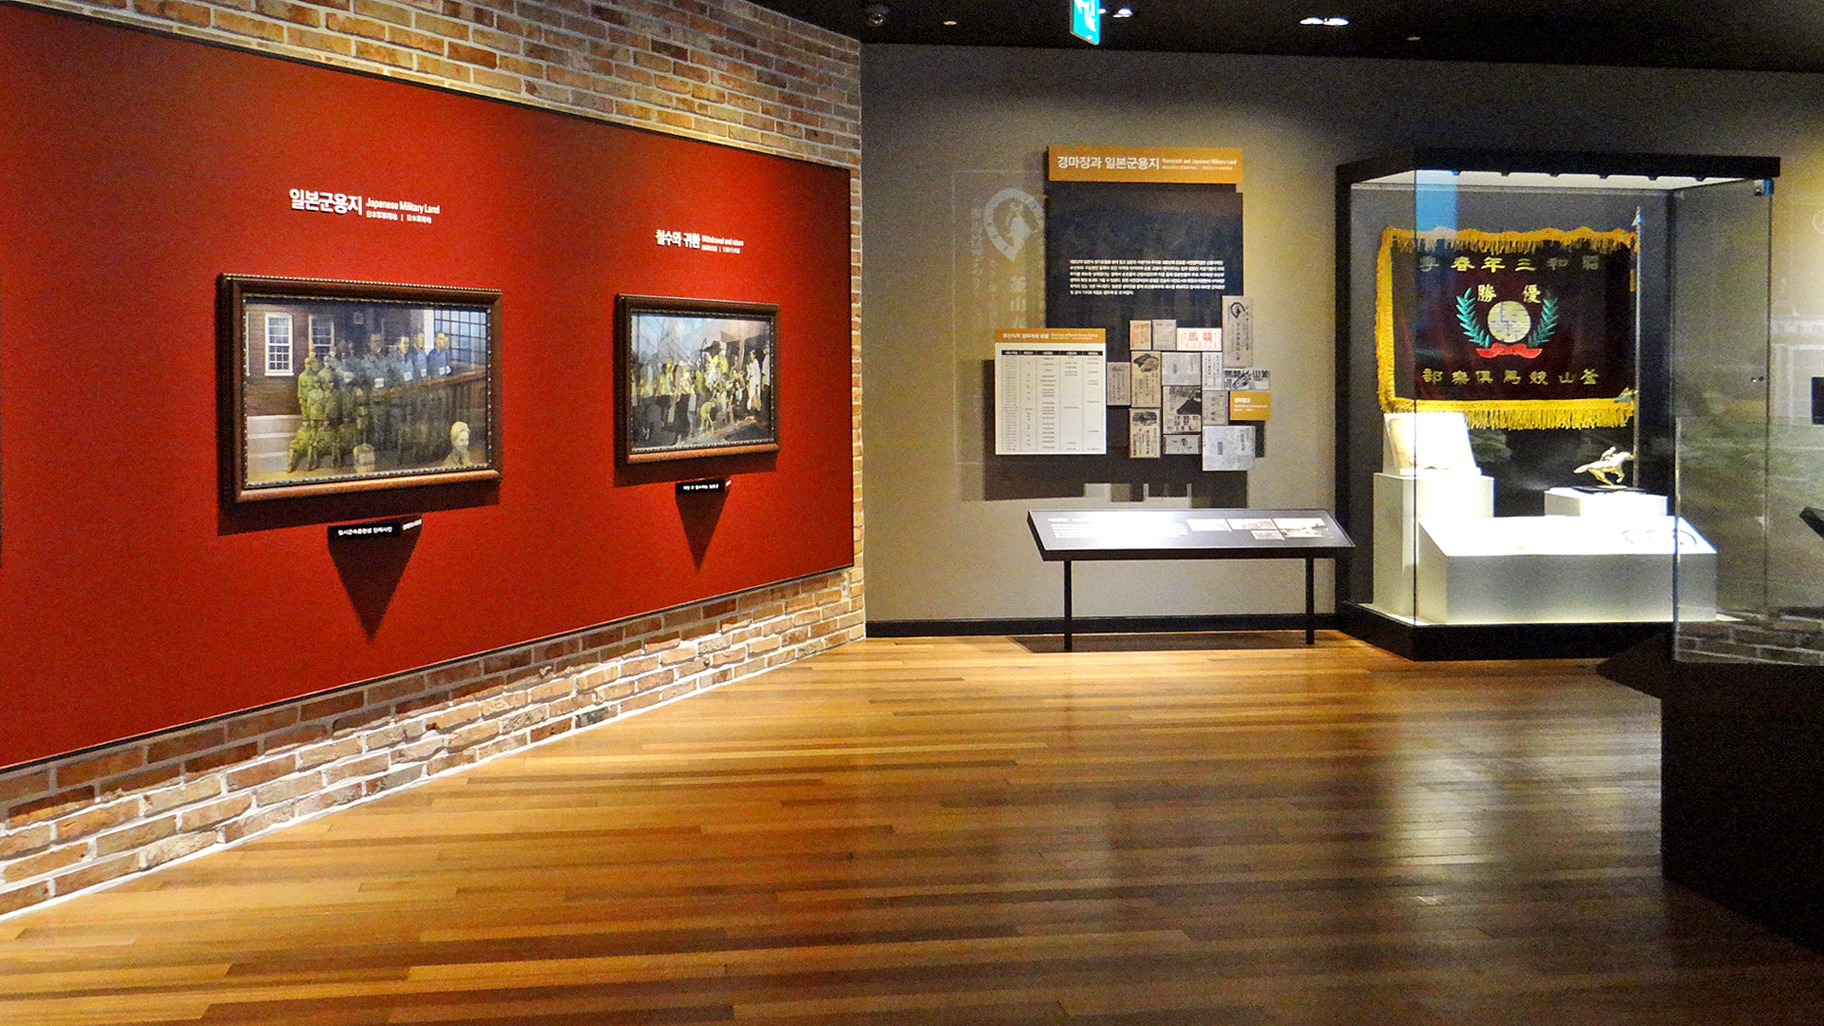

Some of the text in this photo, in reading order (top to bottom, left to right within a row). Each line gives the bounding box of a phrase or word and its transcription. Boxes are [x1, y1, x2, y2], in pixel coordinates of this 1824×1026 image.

[1056, 156, 1159, 170] 경마장과 일본군용지
[289, 188, 363, 216] 일본군용지
[366, 197, 441, 215] Japanese Military Land
[655, 229, 682, 247] 철수와
[683, 232, 700, 249] 귀환
